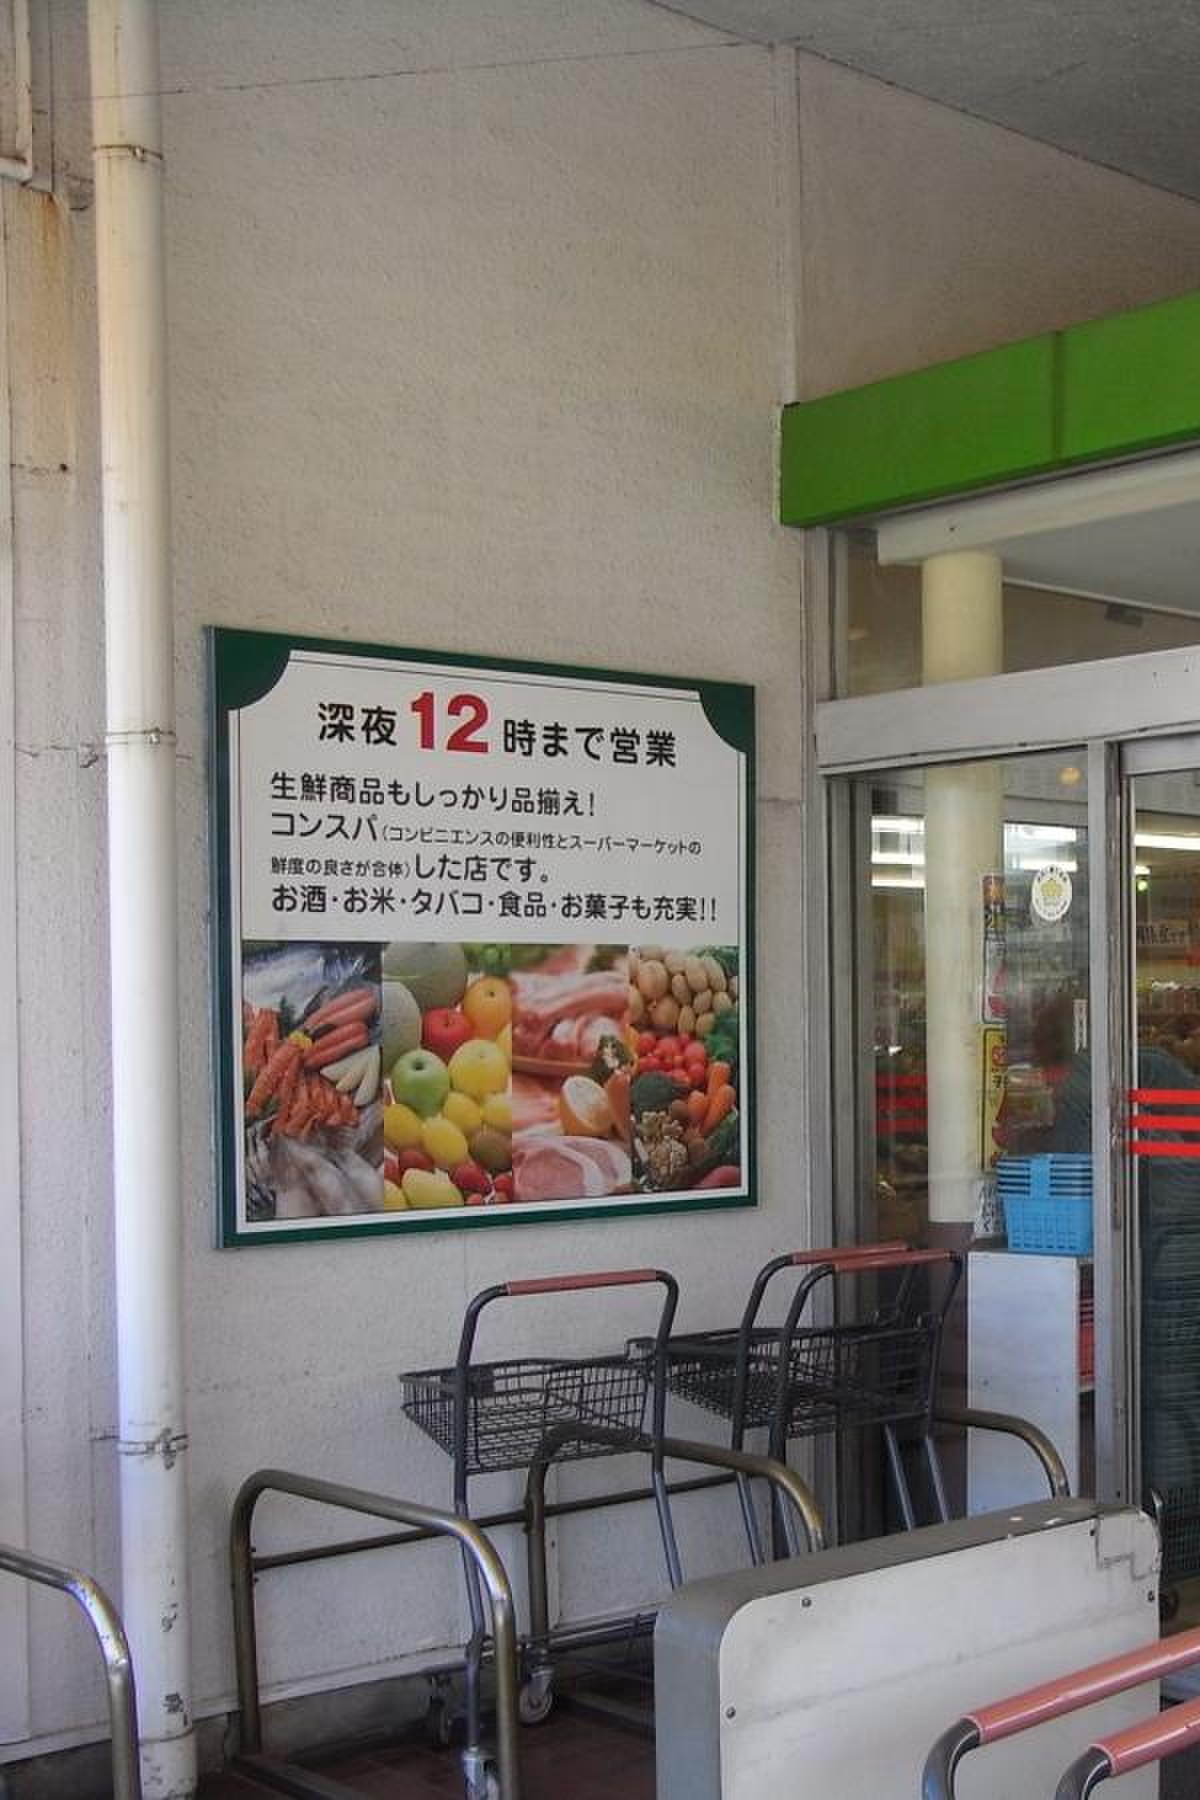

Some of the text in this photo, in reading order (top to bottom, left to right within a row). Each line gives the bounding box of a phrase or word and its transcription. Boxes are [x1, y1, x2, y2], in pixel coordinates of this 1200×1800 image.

[318, 691, 676, 767] 深夜12時まで営業
[271, 771, 595, 817] 生鮮商品もしっかり品揃え!
